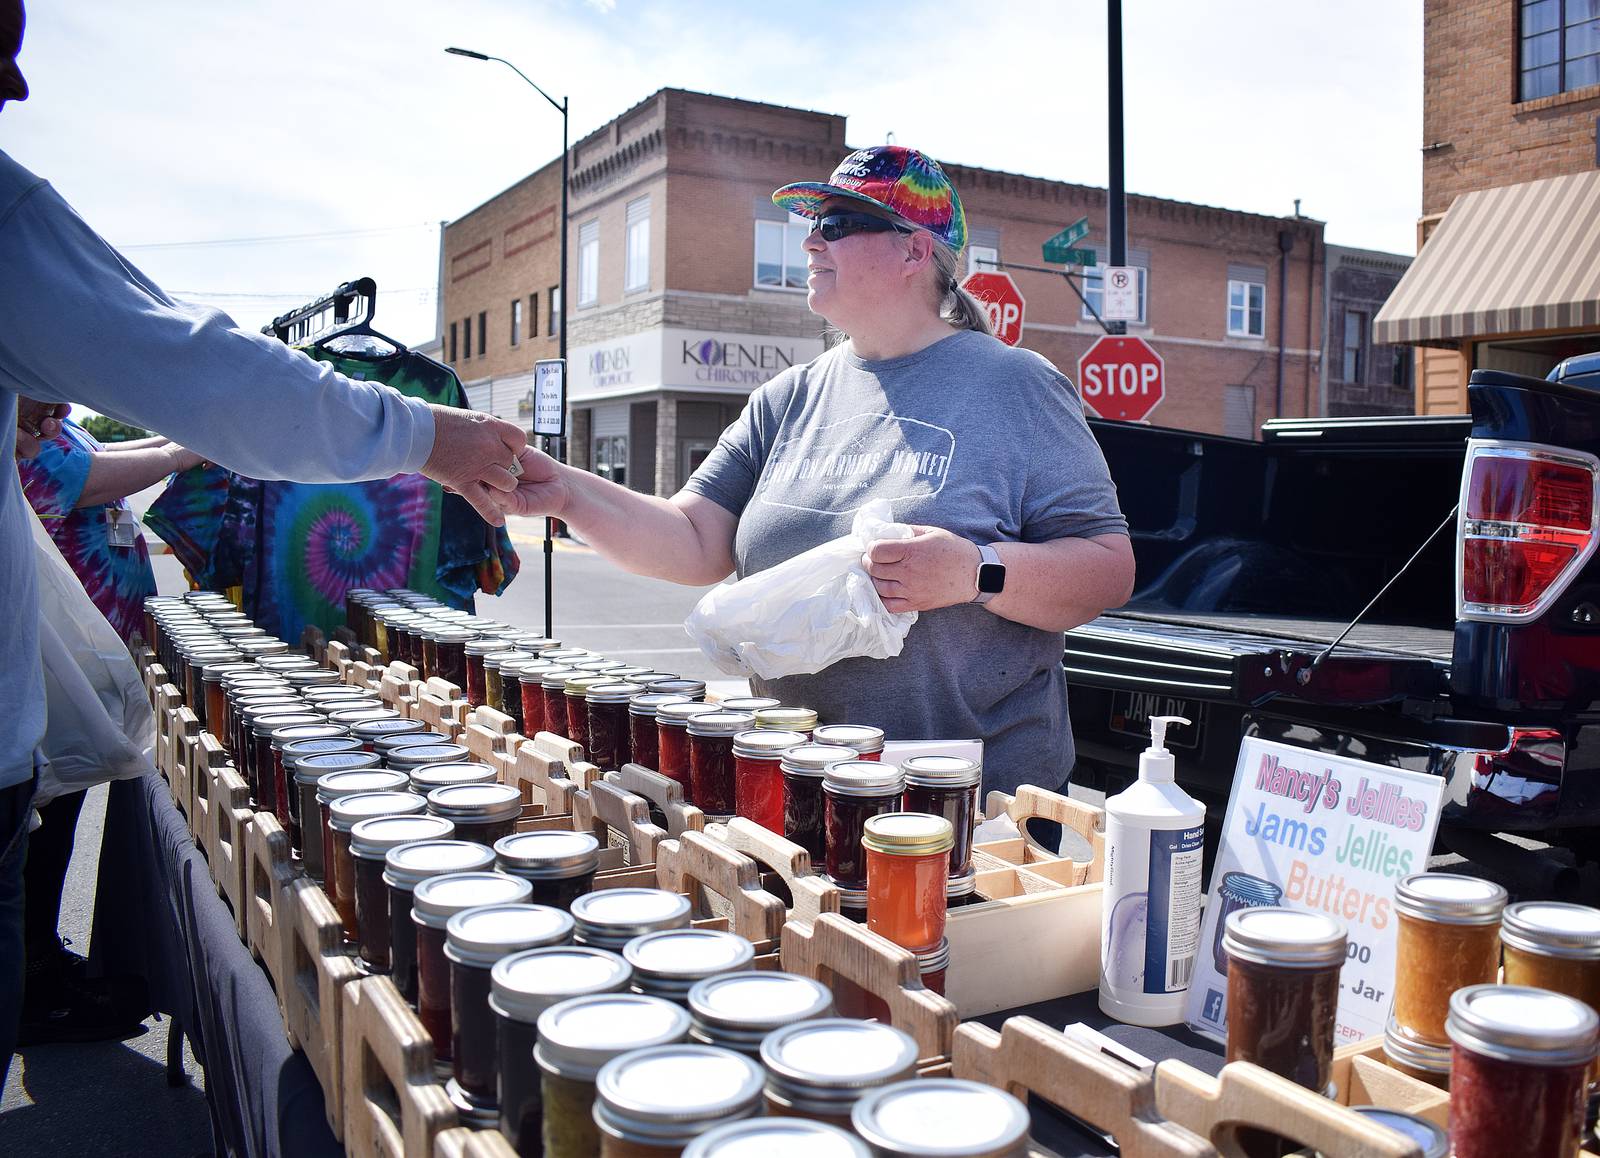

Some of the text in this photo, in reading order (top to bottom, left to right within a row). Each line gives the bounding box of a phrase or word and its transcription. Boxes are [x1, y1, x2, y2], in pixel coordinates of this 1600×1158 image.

[695, 368, 775, 384] CHIROPRA
[1085, 363, 1159, 396] STOP
[889, 450, 947, 477] MARKET
[1255, 753, 1427, 832] Nancy's Jellies
[1183, 830, 1200, 840] Hand
[1245, 802, 1413, 878] Jams Jellies
[1285, 860, 1391, 930] Butters
[1352, 980, 1384, 1002] Jar
[1335, 1023, 1365, 1041] CEPT
